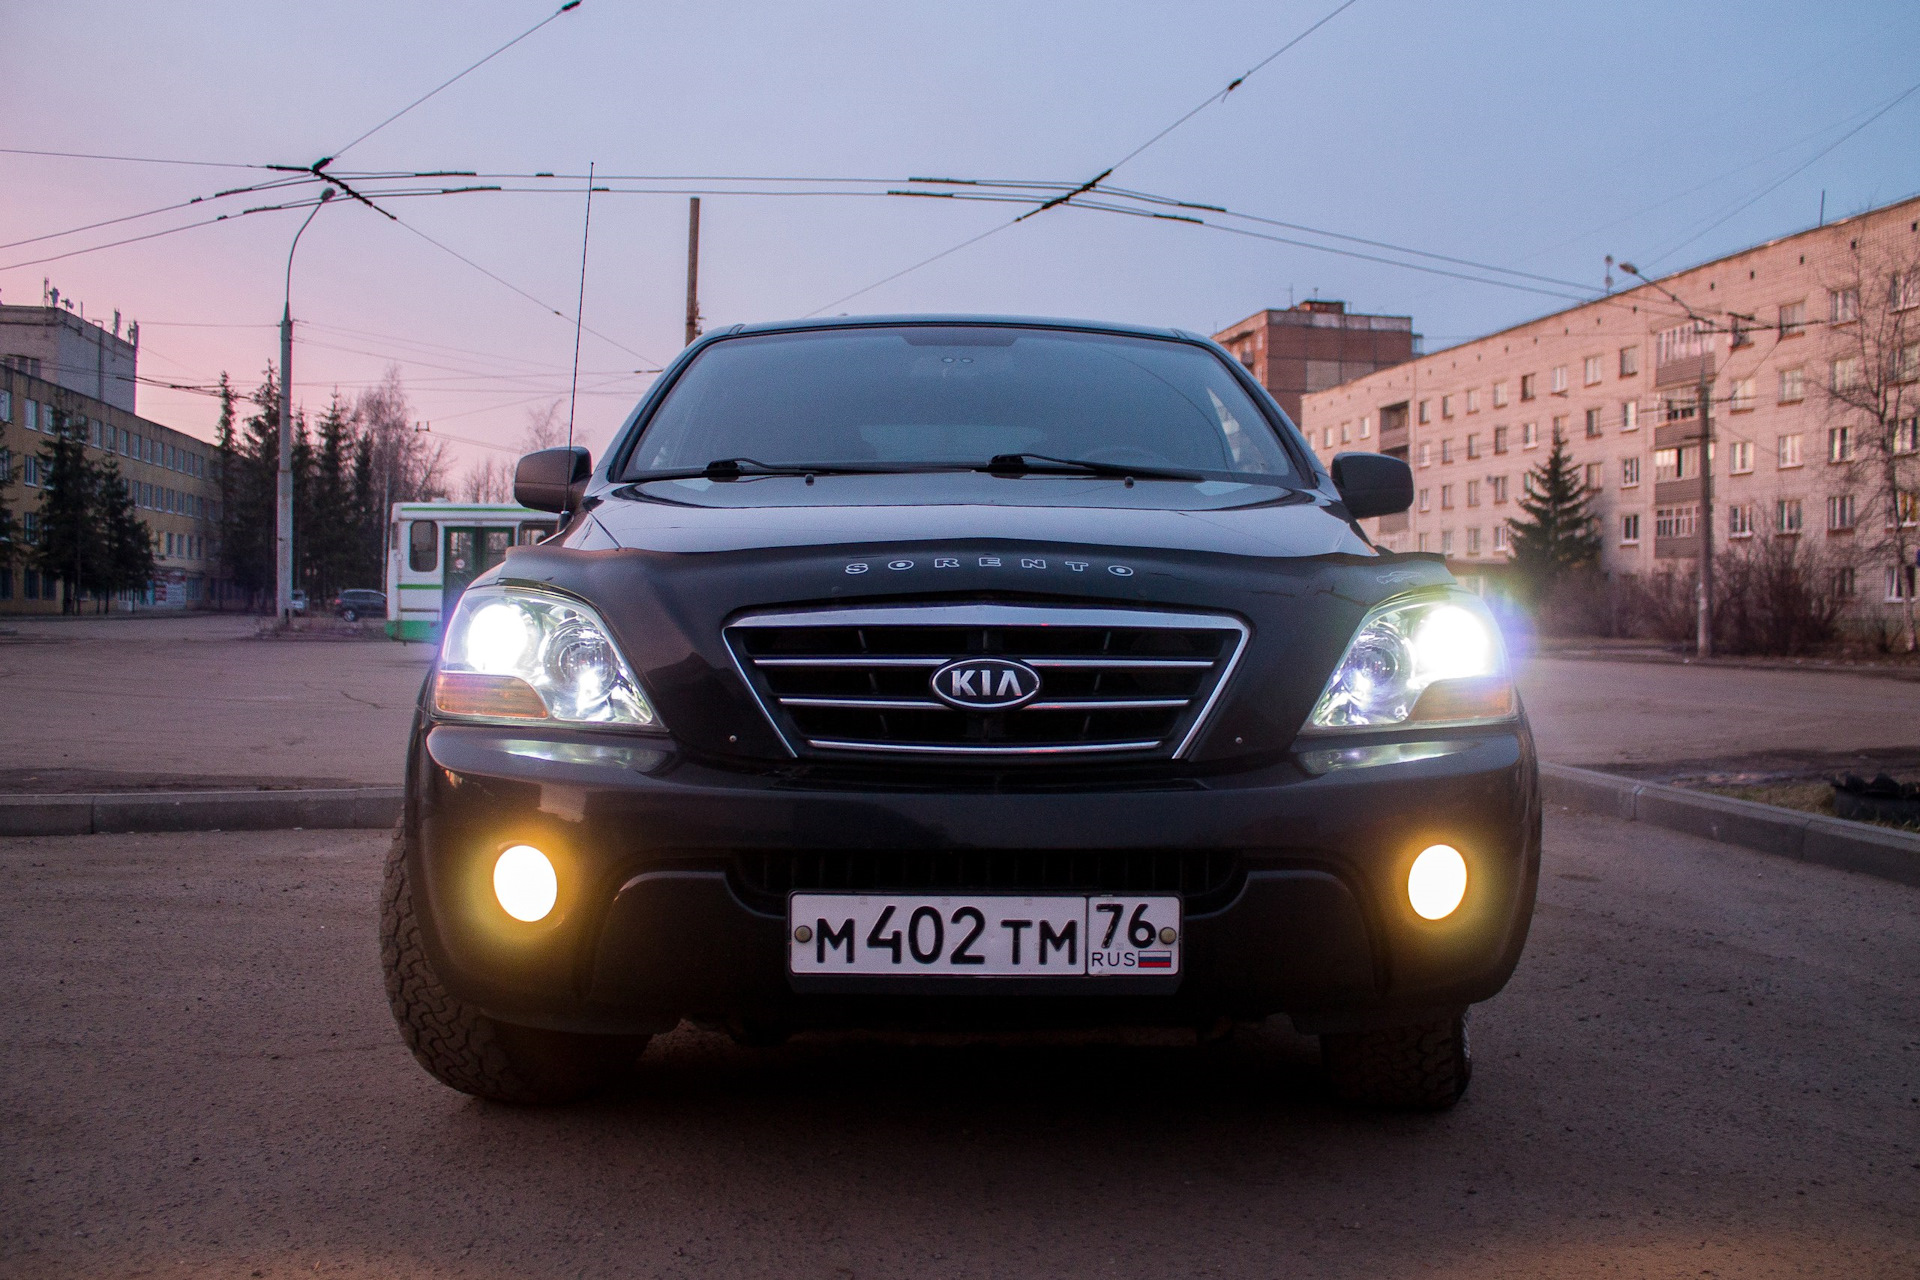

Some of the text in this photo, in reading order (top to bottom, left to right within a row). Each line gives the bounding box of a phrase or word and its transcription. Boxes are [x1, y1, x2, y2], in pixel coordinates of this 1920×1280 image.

[845, 557, 1134, 577] SORENTO
[951, 669, 1023, 697] KIA
[1096, 903, 1157, 949] 76
[1092, 952, 1136, 967] RUS
